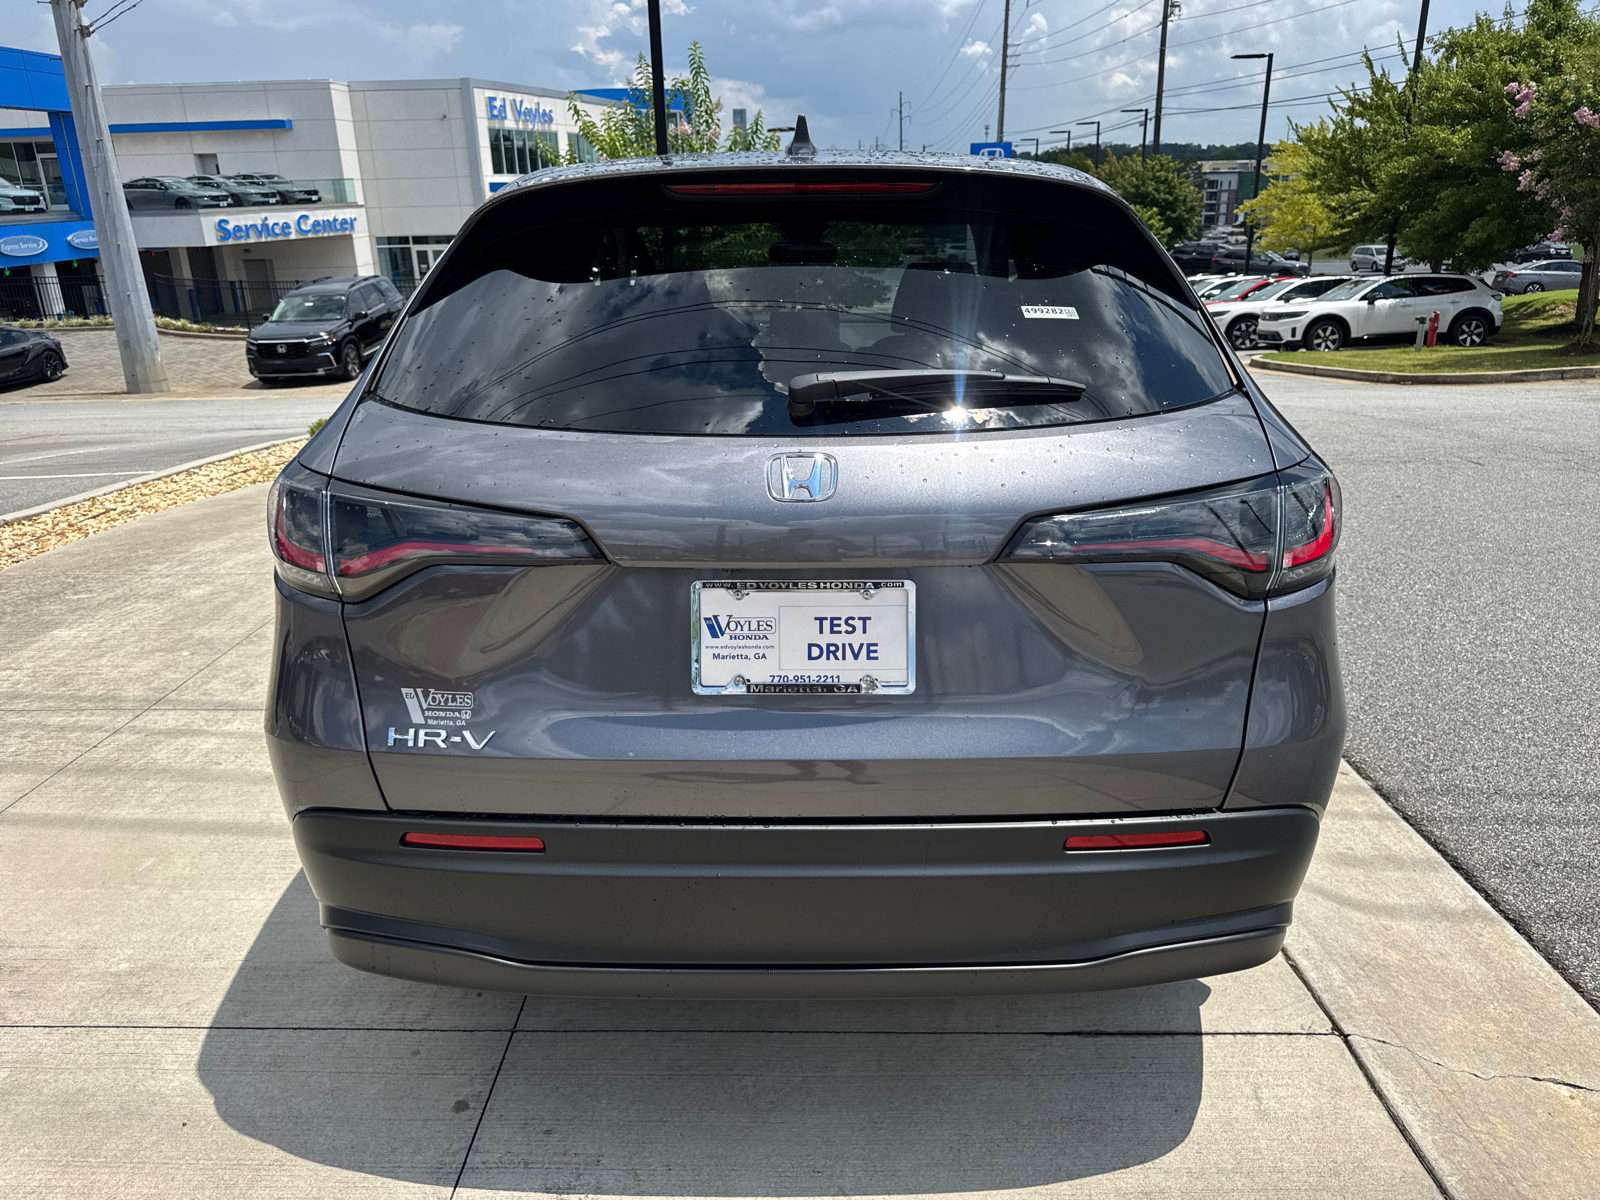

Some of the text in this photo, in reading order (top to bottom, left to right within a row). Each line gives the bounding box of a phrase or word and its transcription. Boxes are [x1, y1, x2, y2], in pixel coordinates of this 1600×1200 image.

[487, 96, 554, 129] Ed Voyles
[217, 214, 358, 242] Service Center
[1, 241, 37, 252] Express Service
[1024, 307, 1065, 315] 499282
[712, 615, 774, 637] VOYLES
[814, 616, 872, 635] TEST
[712, 652, 767, 661] Marietta, GA
[807, 642, 879, 661] DRIVE
[769, 675, 841, 683] 770-951-2211
[750, 684, 859, 694] Marietta, GA
[405, 692, 415, 700] ED
[415, 688, 472, 710] VOYLES
[424, 710, 461, 718] HONDA
[427, 719, 456, 727] Marietta,
[387, 727, 497, 750] HR-V
